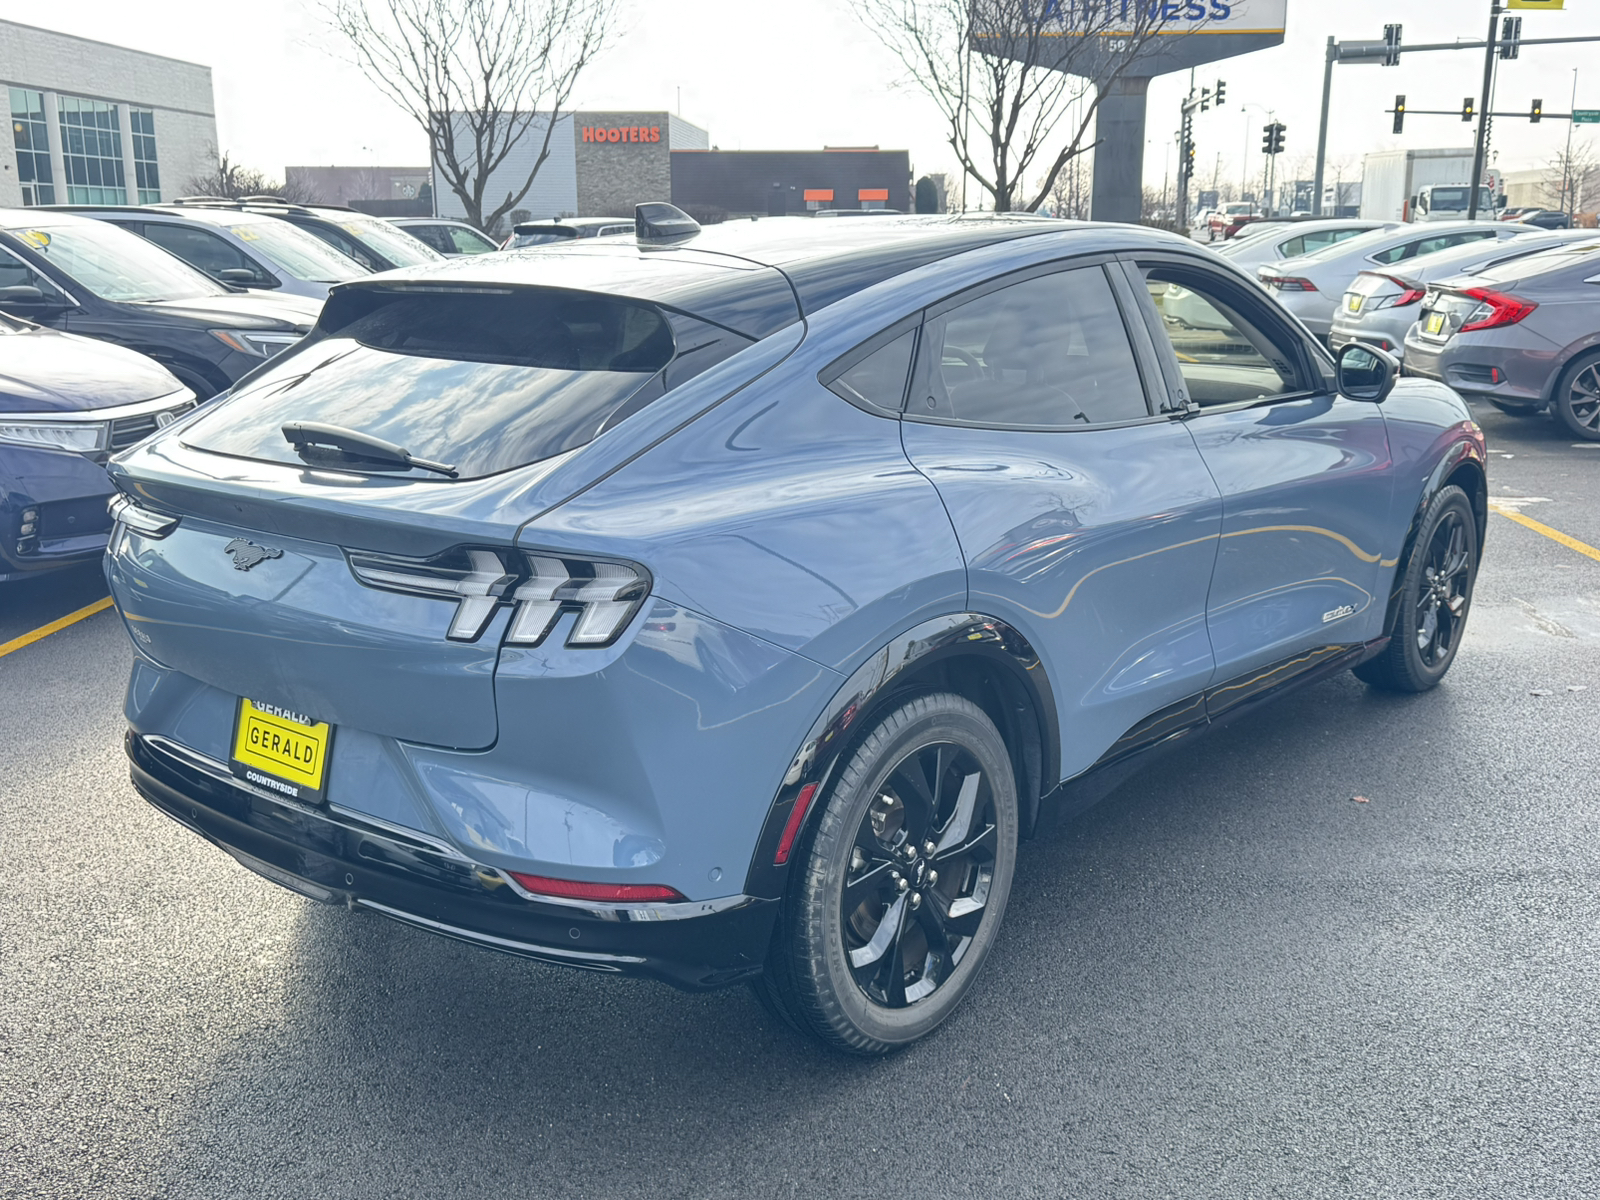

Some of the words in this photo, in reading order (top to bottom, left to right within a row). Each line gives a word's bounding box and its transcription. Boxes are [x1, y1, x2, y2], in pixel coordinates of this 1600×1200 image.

[582, 126, 661, 143] HOOTERS
[250, 727, 313, 763] GERALD
[246, 771, 299, 797] COUNTRYSIDE
